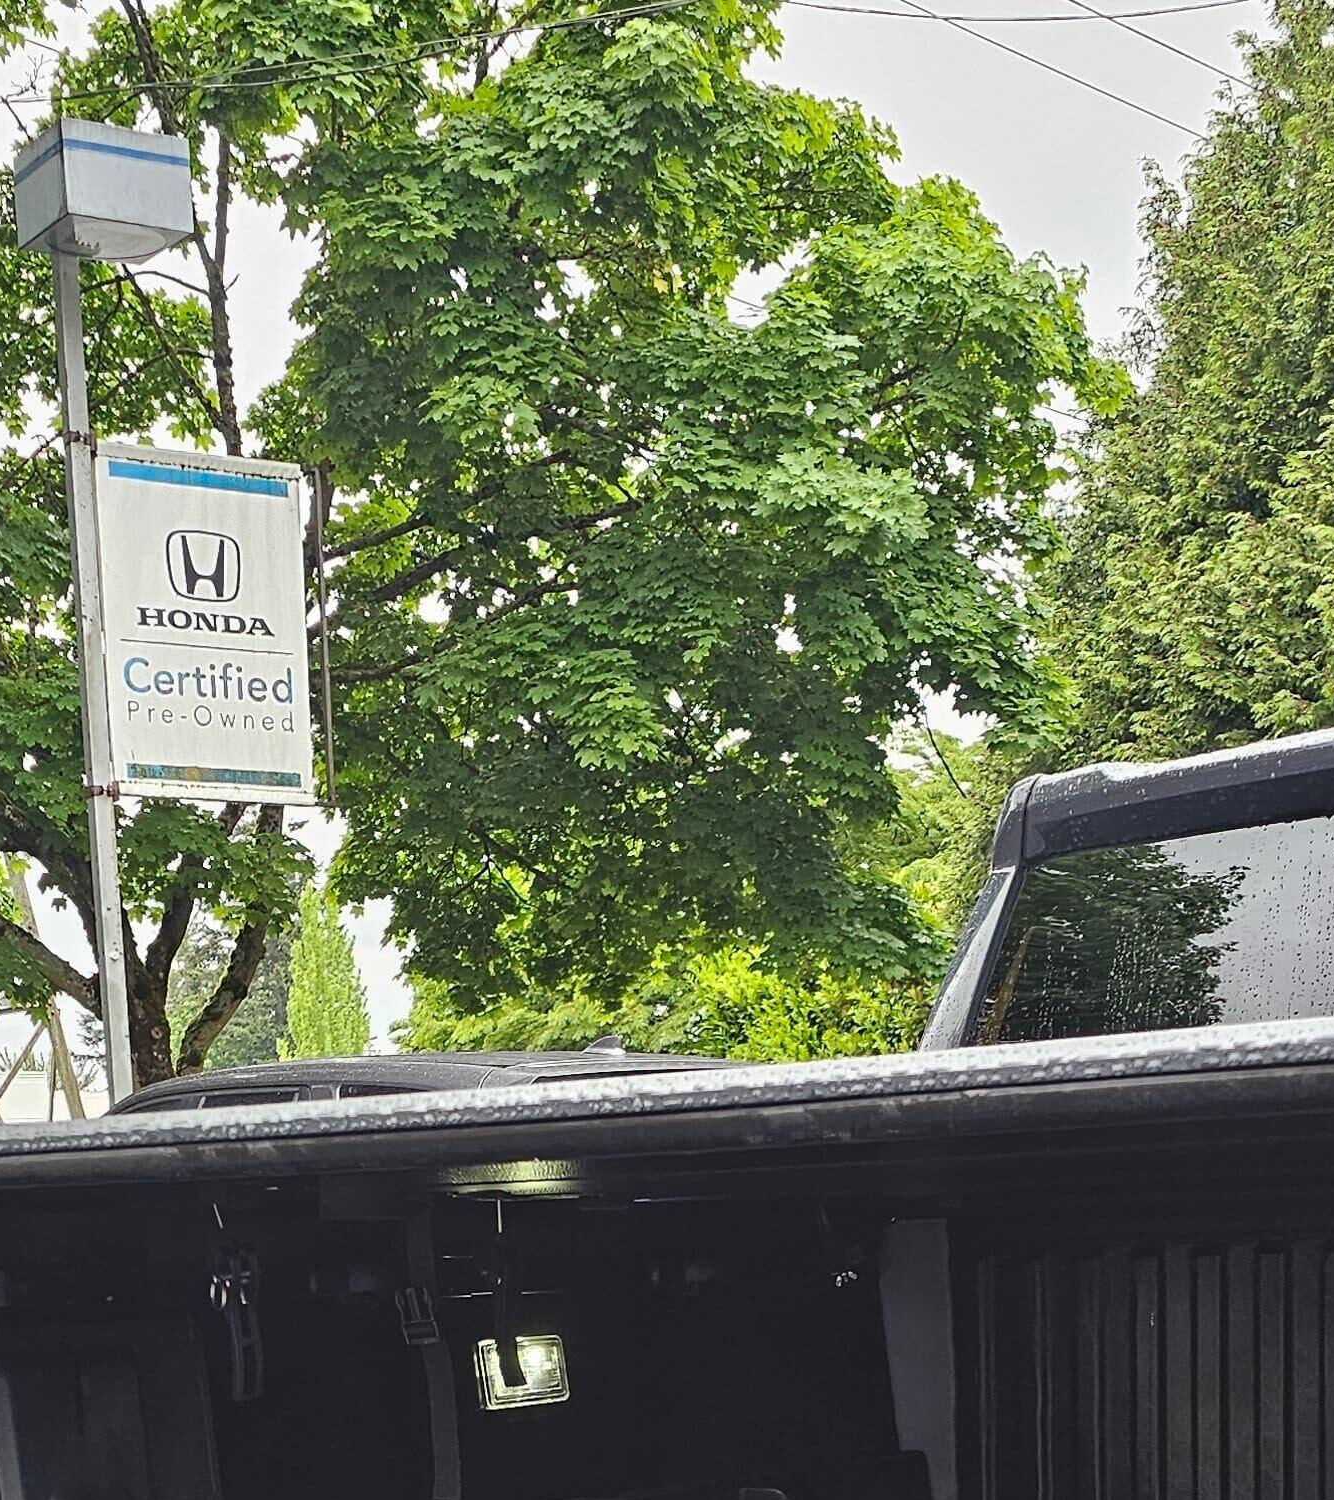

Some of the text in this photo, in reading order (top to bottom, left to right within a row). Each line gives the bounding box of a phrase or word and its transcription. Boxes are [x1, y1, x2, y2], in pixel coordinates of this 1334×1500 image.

[136, 606, 276, 637] HONDA
[123, 656, 294, 705] Certified
[127, 700, 295, 733] Pre-Owned
